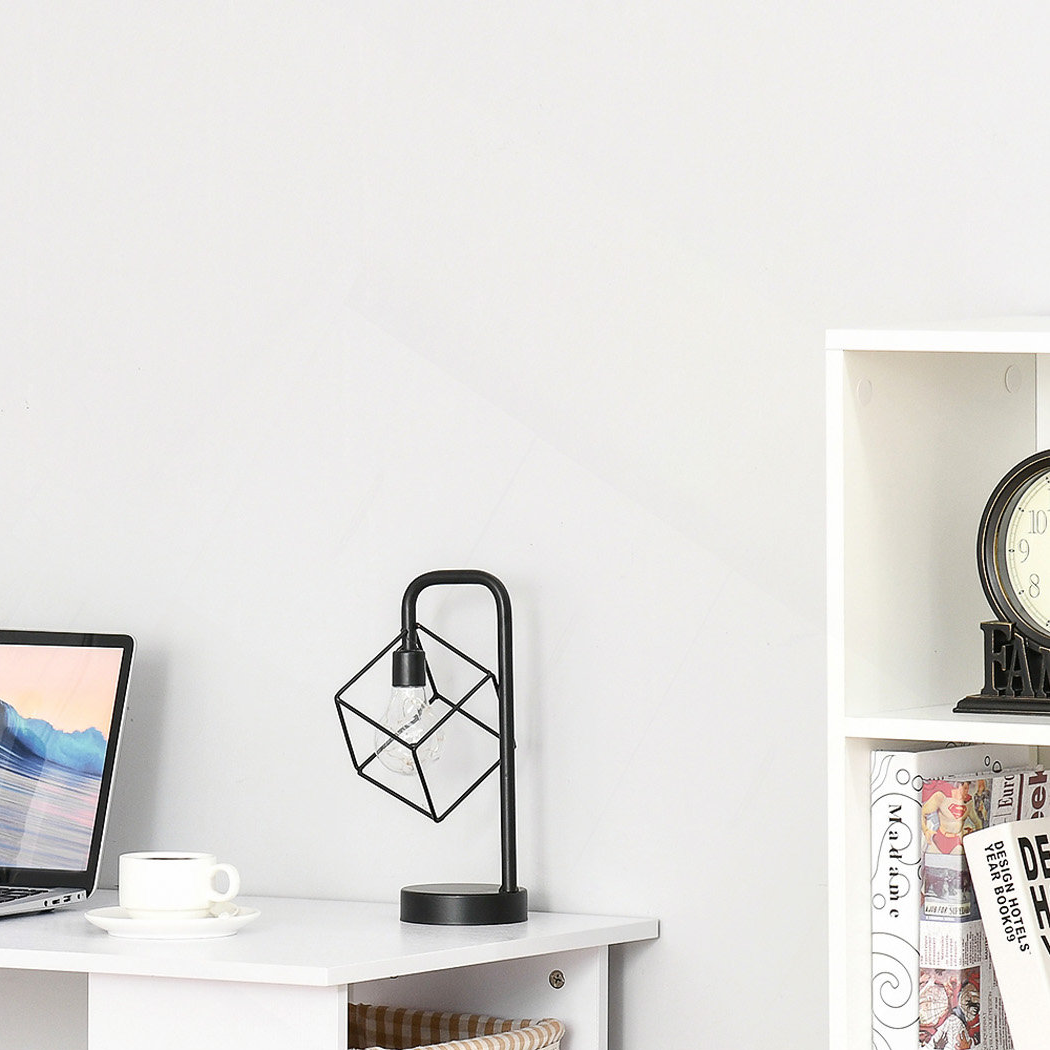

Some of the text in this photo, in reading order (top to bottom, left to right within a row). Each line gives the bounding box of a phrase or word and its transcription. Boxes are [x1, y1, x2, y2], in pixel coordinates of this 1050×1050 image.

[1028, 509, 1048, 534] 10
[1018, 538, 1031, 563] 9
[1028, 573, 1040, 598] 8
[888, 804, 902, 918] Madame
[984, 843, 1001, 881] YEAR
[994, 841, 1030, 952] DESIGN HOTELS
